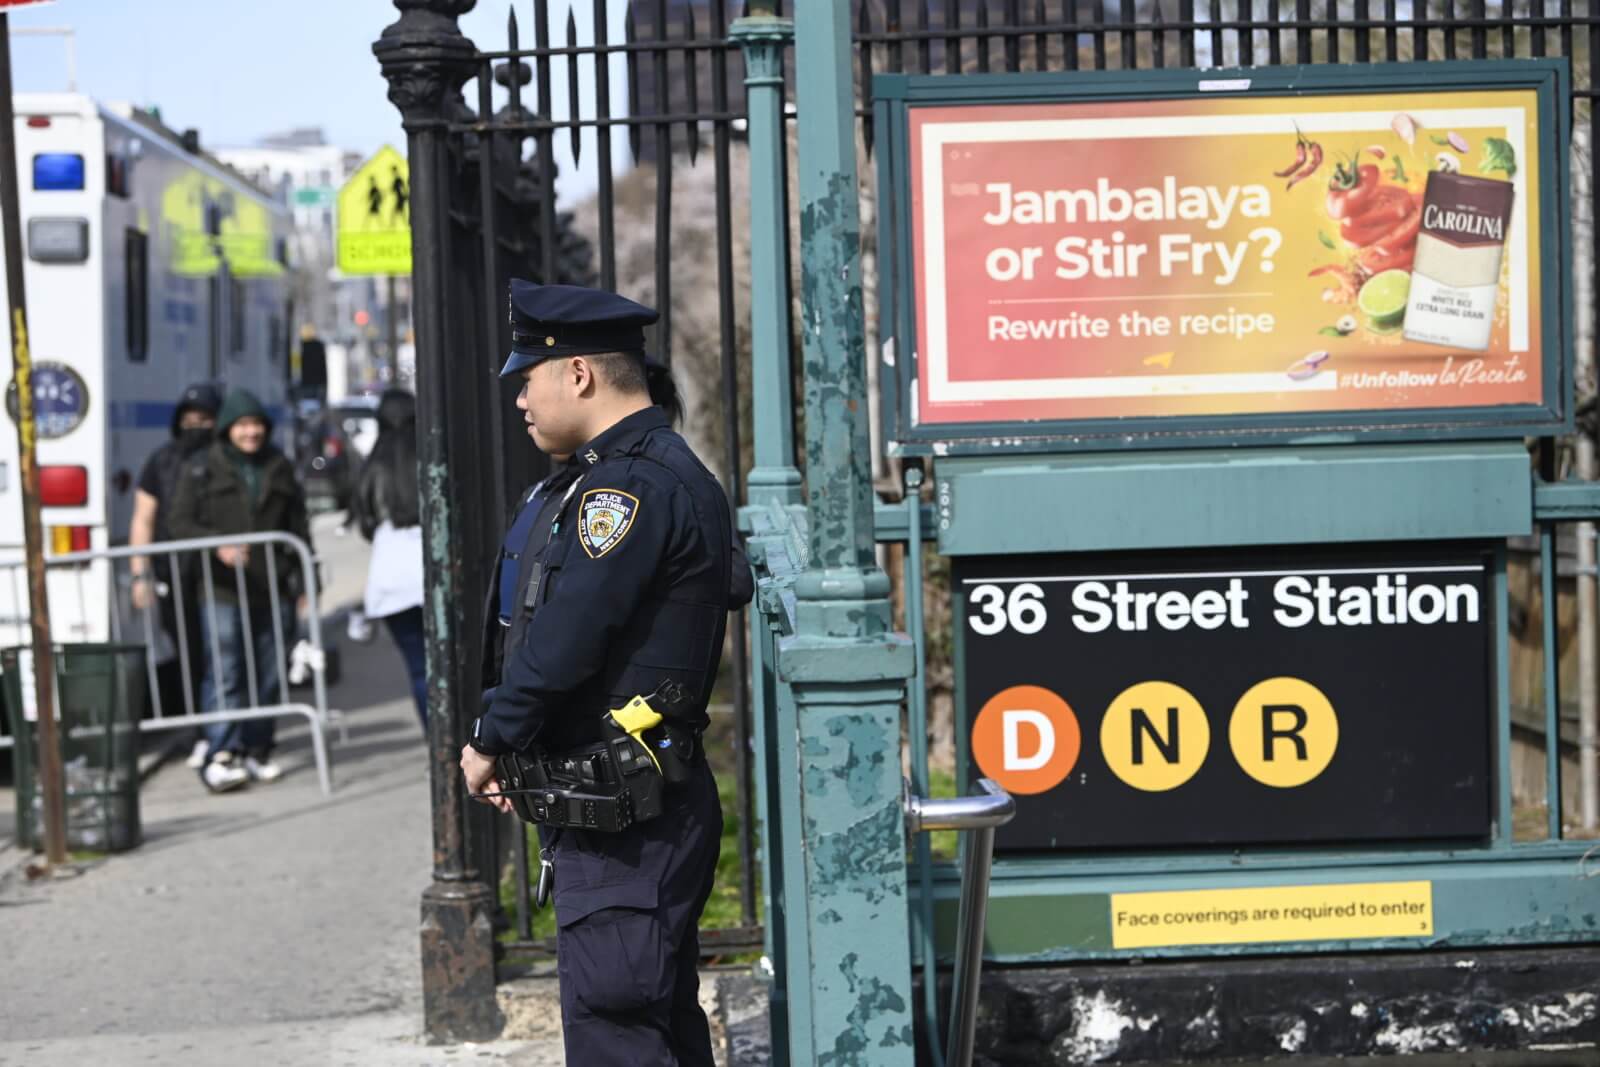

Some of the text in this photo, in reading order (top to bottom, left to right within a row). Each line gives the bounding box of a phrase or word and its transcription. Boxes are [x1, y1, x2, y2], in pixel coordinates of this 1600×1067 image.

[984, 176, 1270, 229] Jambalaya
[1424, 204, 1503, 240] CAROLINA
[985, 227, 1282, 285] or Stir Fry?
[988, 307, 1274, 341] Rewrite the recipe
[584, 500, 631, 515] DEPARTMENT
[595, 493, 622, 503] POLICE
[969, 574, 1479, 635] 36 Street Station
[1002, 704, 1308, 771] D N R
[1117, 900, 1426, 927] Face coverings are required to enter
